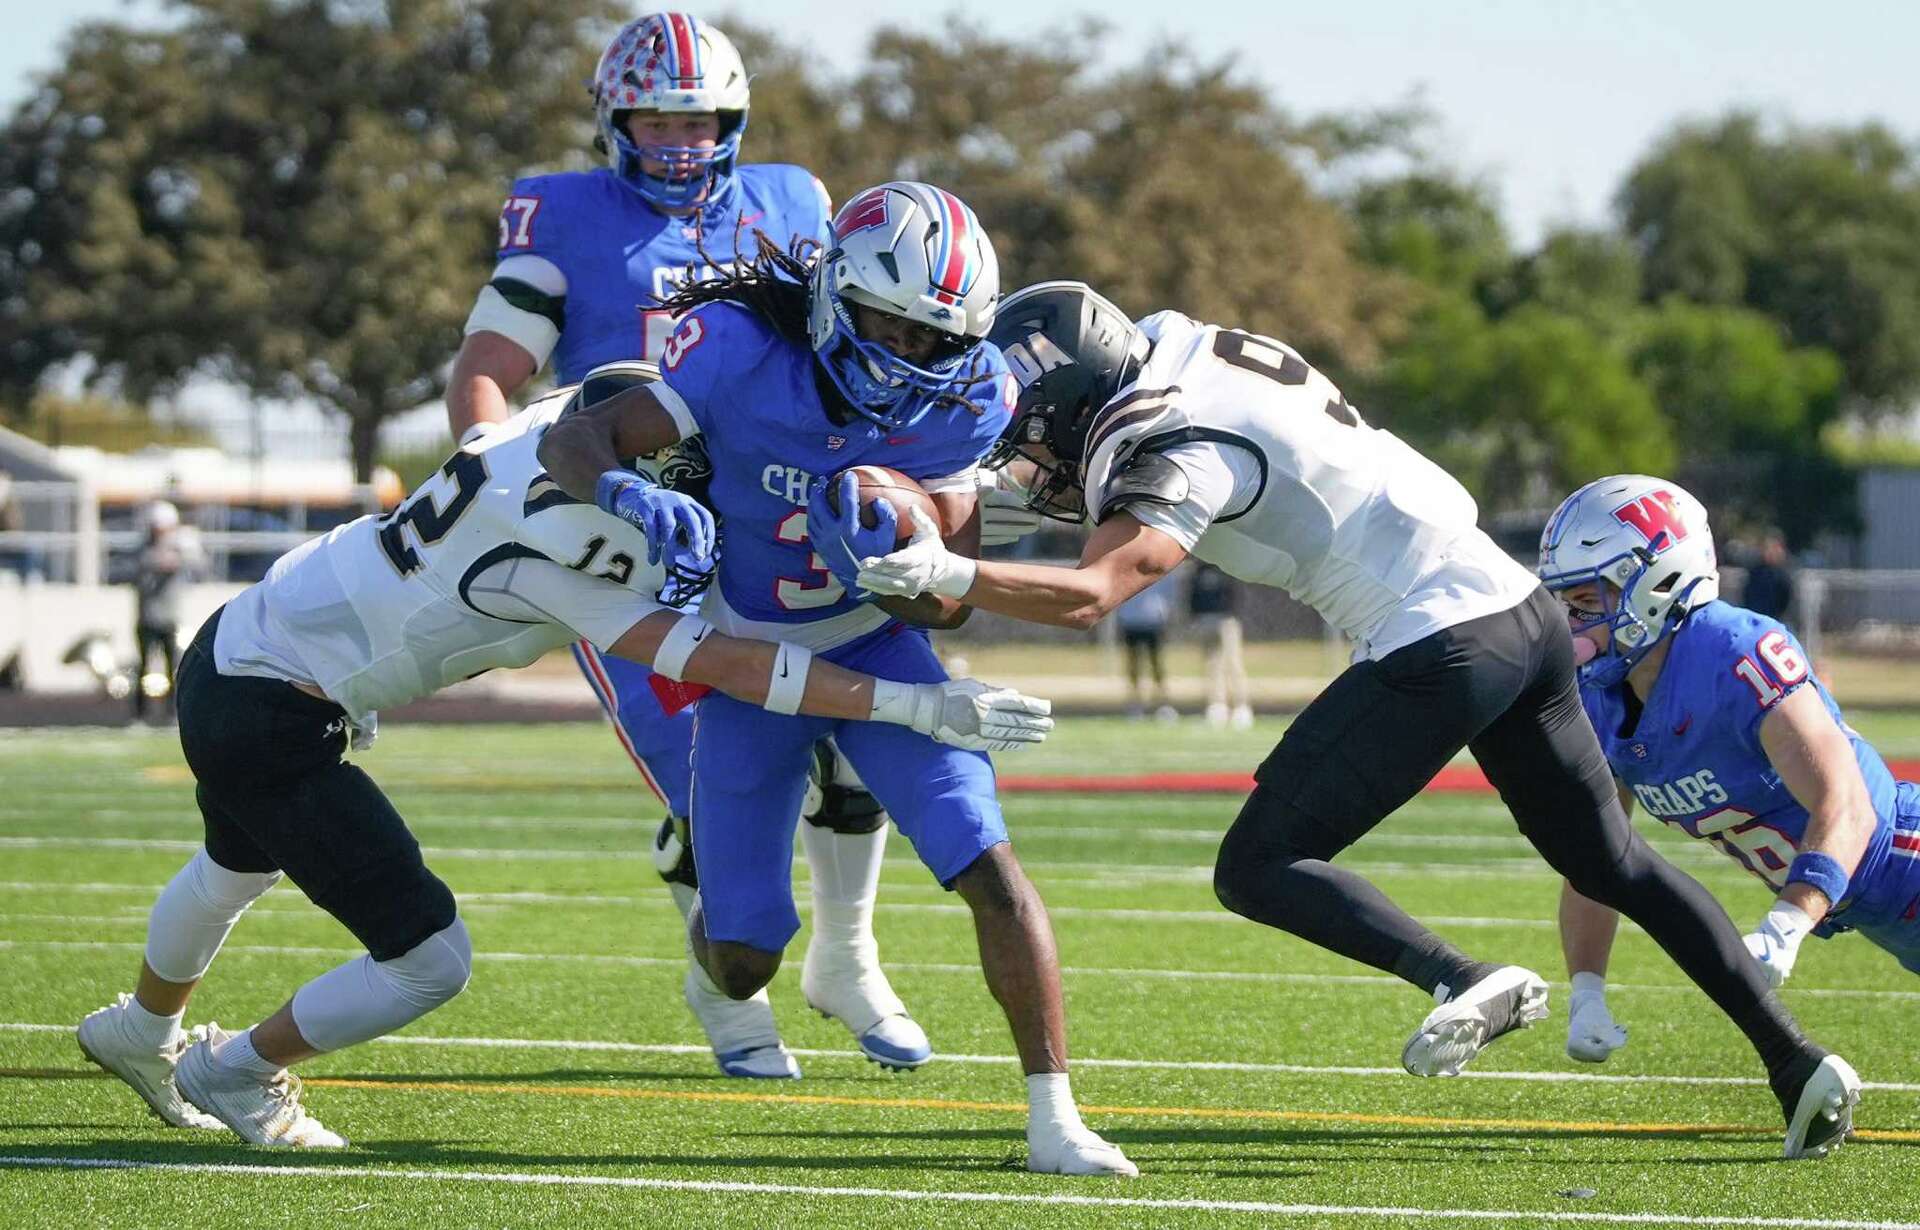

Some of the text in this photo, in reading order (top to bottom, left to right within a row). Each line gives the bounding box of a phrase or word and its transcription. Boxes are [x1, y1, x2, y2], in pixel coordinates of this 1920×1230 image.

[836, 188, 889, 243] W
[664, 316, 706, 373] 3
[374, 449, 491, 580] 12
[1611, 489, 1689, 554] W
[568, 536, 634, 585] 12
[1733, 629, 1808, 710] 16
[1633, 768, 1729, 817] CHAPS
